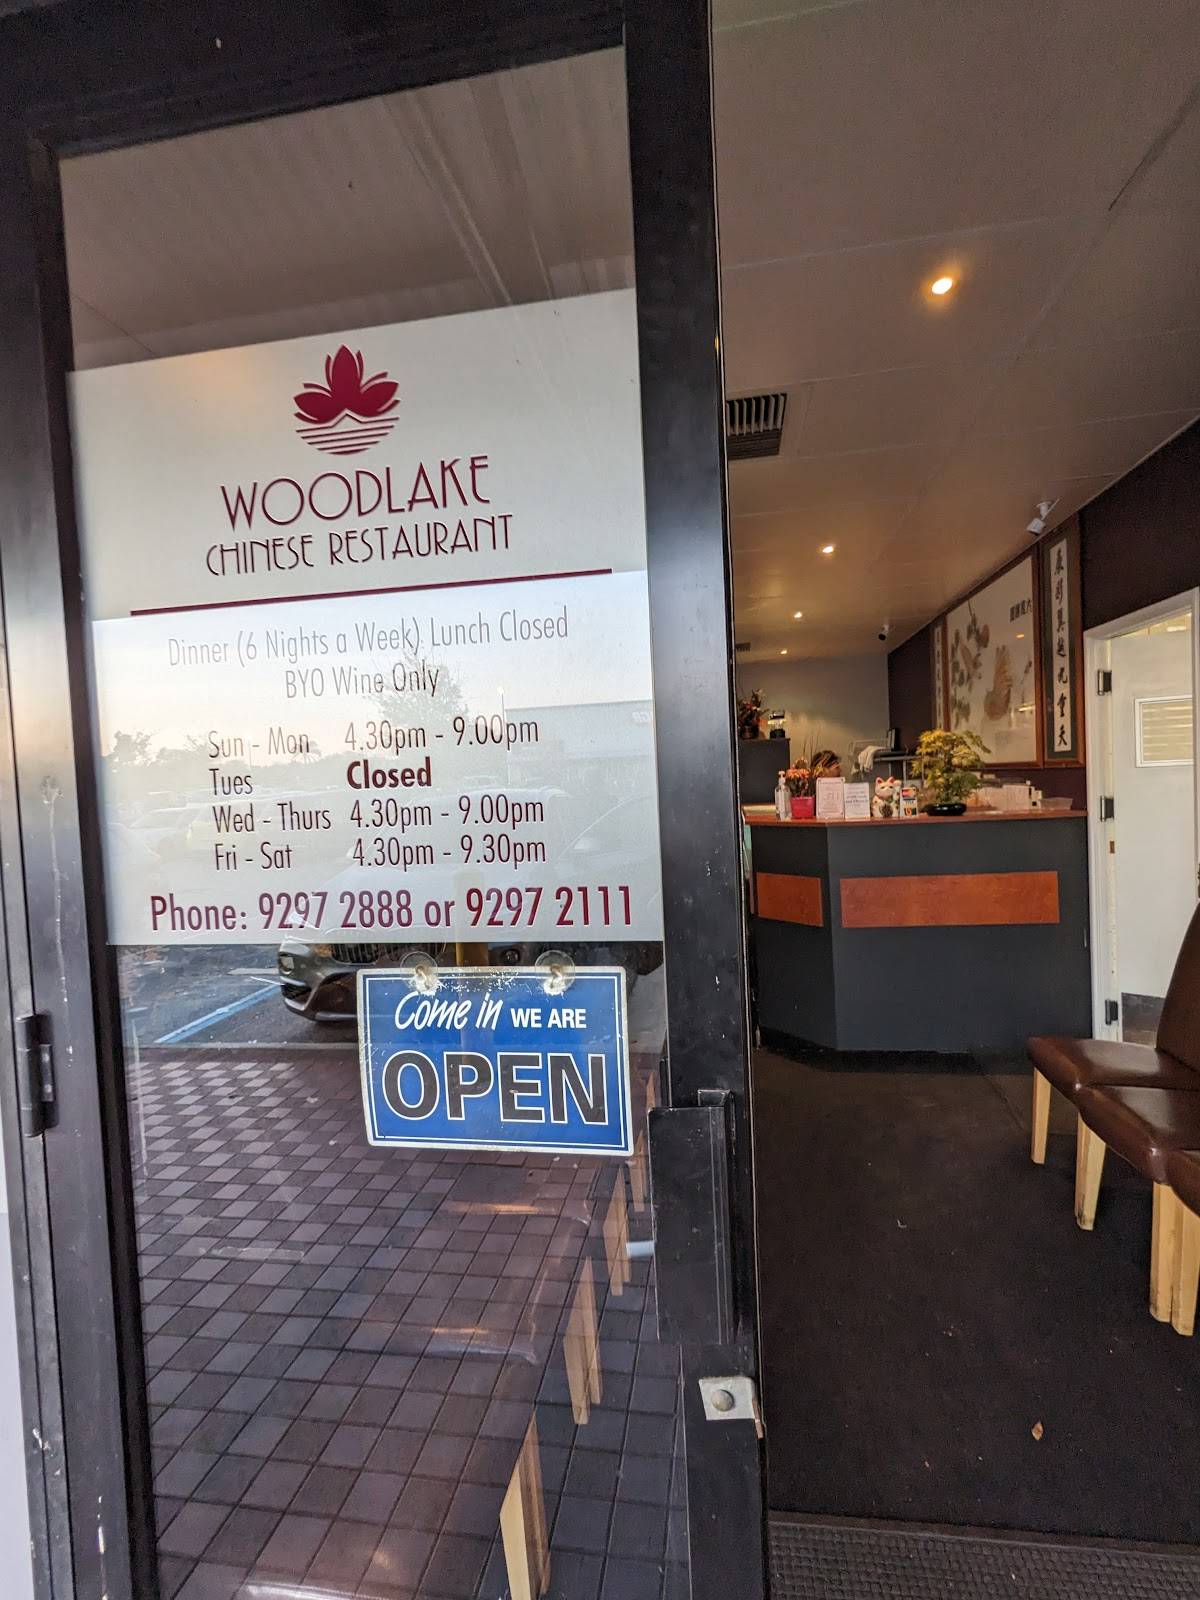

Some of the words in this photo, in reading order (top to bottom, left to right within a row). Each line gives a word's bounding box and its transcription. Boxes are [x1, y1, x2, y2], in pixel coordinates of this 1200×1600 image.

[220, 456, 490, 531] WOODLAKE
[206, 534, 314, 576] CHINESE
[329, 515, 513, 565] RESTAURANT
[168, 637, 228, 666] Dinner
[237, 631, 258, 667] (6
[266, 626, 329, 664] Nights
[336, 634, 347, 654] a
[354, 625, 422, 655] Week)
[430, 613, 490, 647] Lunch
[500, 606, 568, 641] Closed
[285, 669, 325, 698] BYO
[332, 665, 383, 695] Wine
[392, 661, 439, 698] Only
[208, 730, 245, 758] Sun
[267, 728, 310, 755] Mon
[344, 720, 427, 756] 4.30pm
[452, 715, 539, 750] 9.00pm
[209, 768, 253, 795] Tues
[347, 758, 432, 790] Closed
[213, 804, 255, 833] Wed
[276, 802, 331, 831] Thurs
[350, 800, 432, 833] 4.30pm
[458, 795, 544, 829] 9.00pm
[214, 843, 239, 871] Fri
[260, 844, 292, 869] Sat
[352, 839, 434, 871] 4.30pm
[460, 835, 546, 868] 9.30pm
[151, 893, 247, 930] Phone:
[259, 892, 327, 929] 9297
[339, 890, 412, 928] 2888
[424, 900, 455, 927] or
[466, 887, 543, 927] 9297
[556, 885, 632, 925] 2111
[395, 991, 472, 1030] Come
[475, 992, 503, 1030] in
[511, 1009, 542, 1028] WE
[548, 1008, 586, 1028] ARE
[382, 1050, 608, 1126] OPEN
